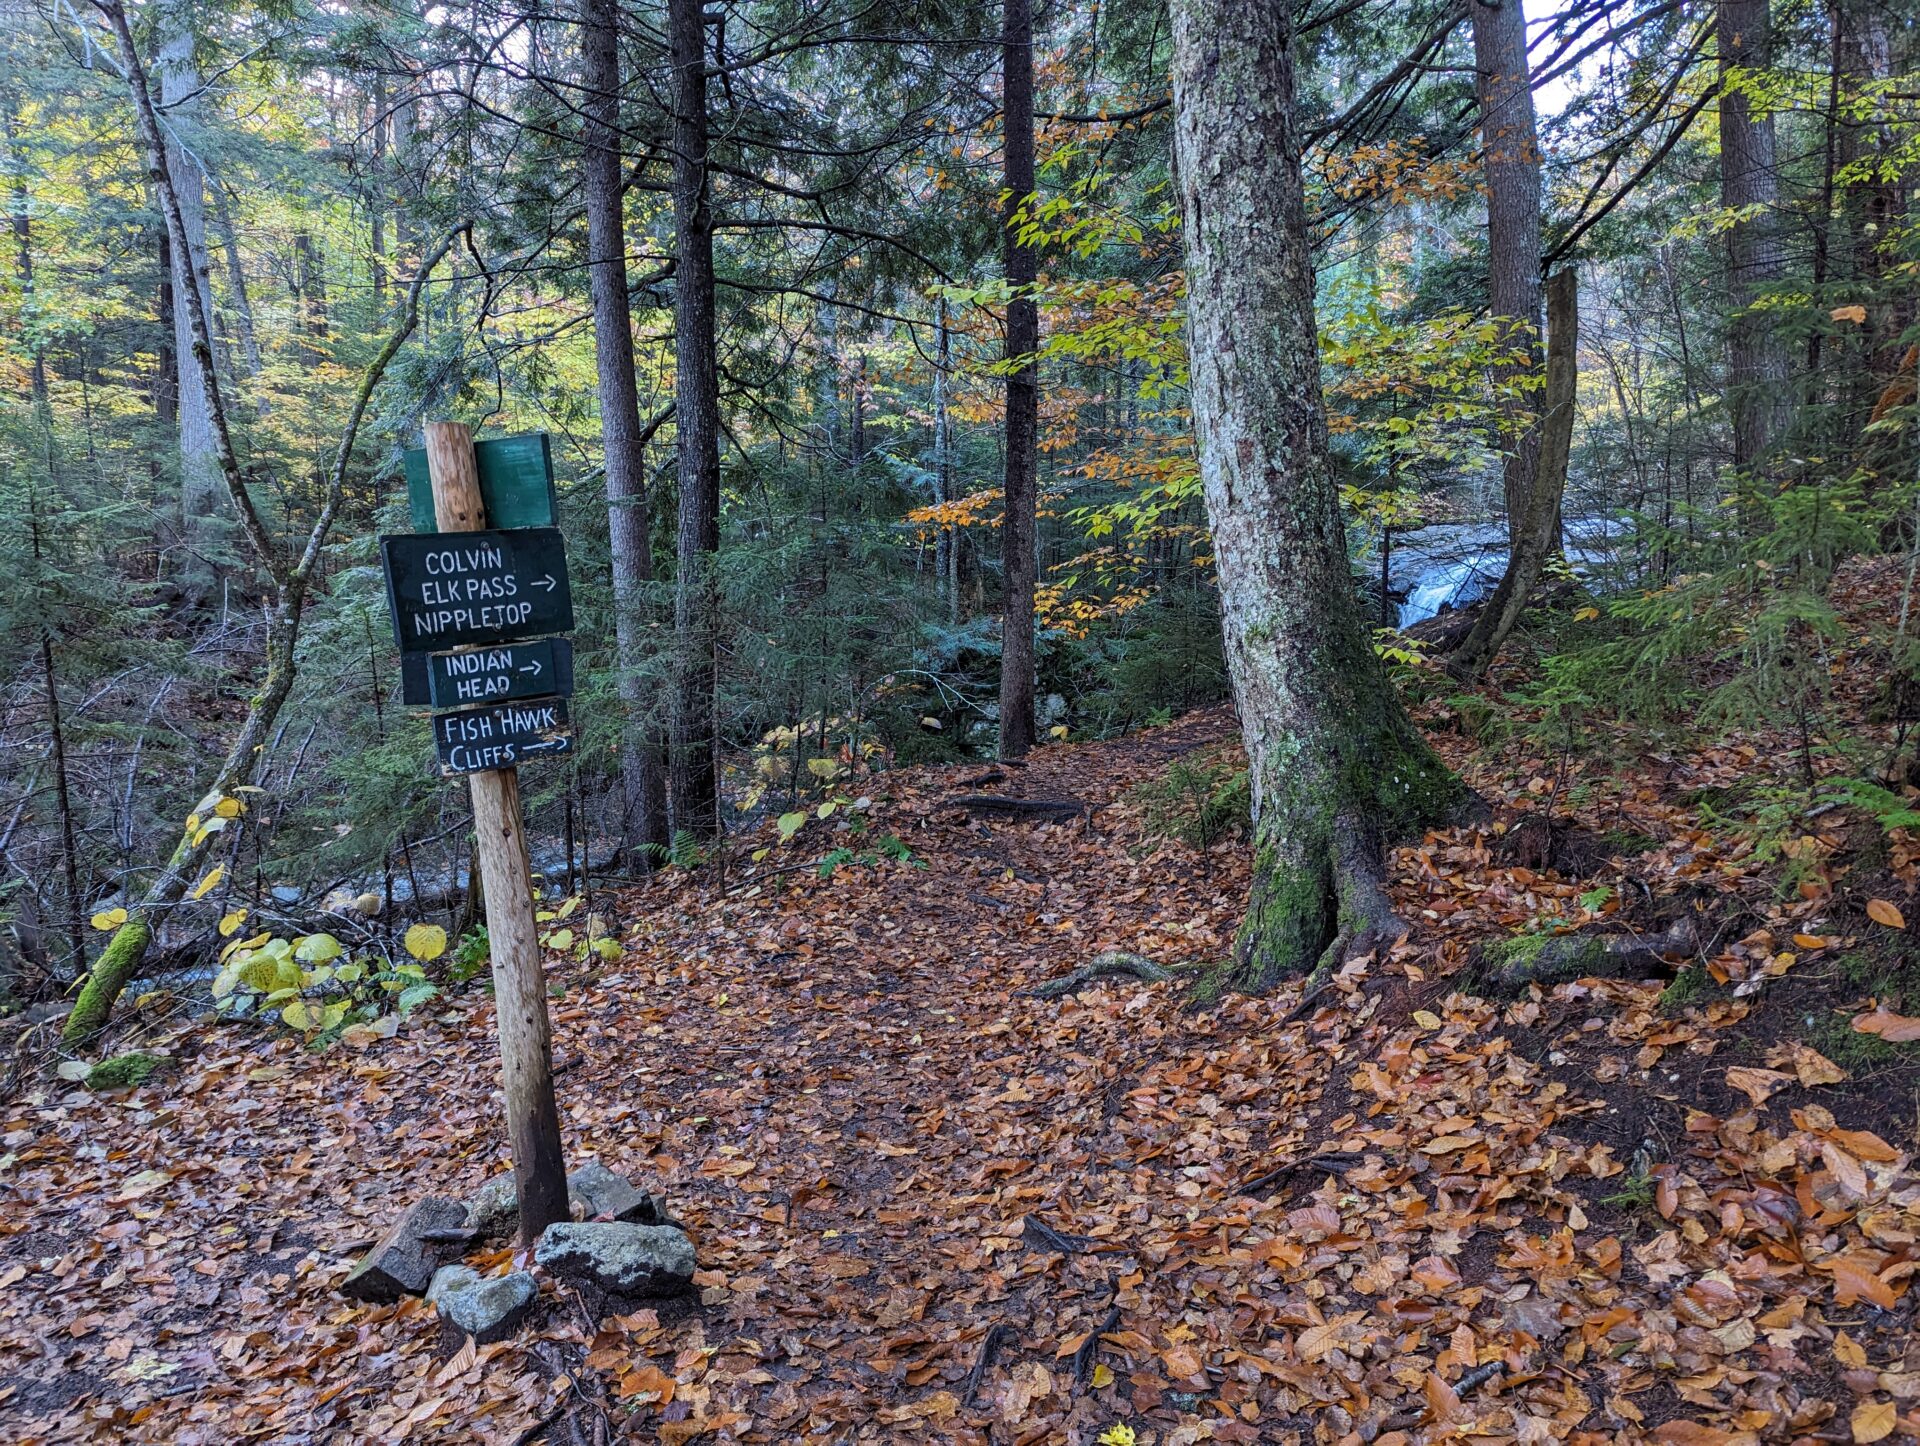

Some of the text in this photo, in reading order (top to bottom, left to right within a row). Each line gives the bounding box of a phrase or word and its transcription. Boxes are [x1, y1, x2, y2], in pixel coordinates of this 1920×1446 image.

[425, 548, 502, 574] COLVIN
[421, 576, 517, 605] ELK PASS
[414, 603, 532, 635] NIPPLETOP
[446, 651, 513, 676] INDIAN
[458, 677, 510, 699] HEAD
[445, 708, 557, 743] FISH HAWK
[451, 744, 516, 772] CLIFFS
